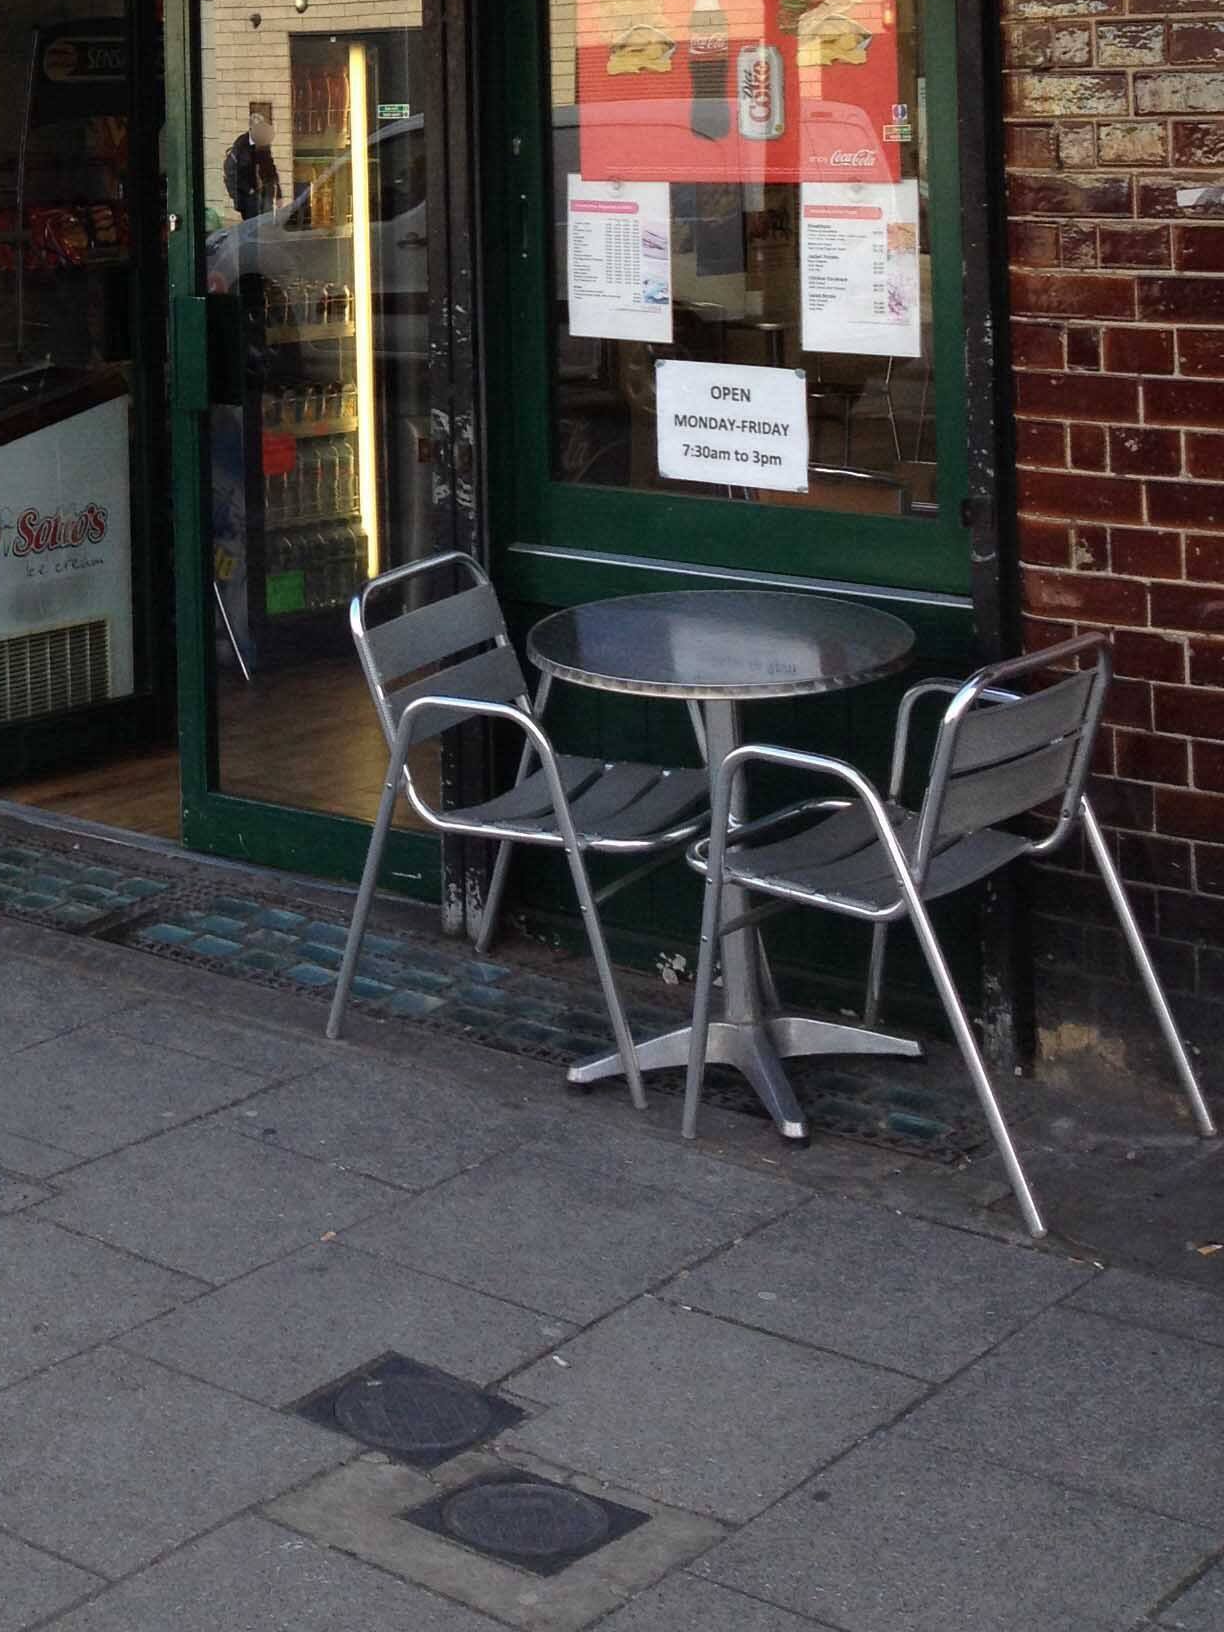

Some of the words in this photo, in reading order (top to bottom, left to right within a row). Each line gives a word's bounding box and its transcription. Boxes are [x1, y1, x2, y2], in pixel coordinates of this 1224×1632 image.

[710, 384, 752, 403] OPEN
[673, 413, 790, 437] MONDAY-FRIDAY
[681, 443, 732, 461] 7:30am
[734, 449, 750, 462] to
[752, 449, 783, 468] 3pm
